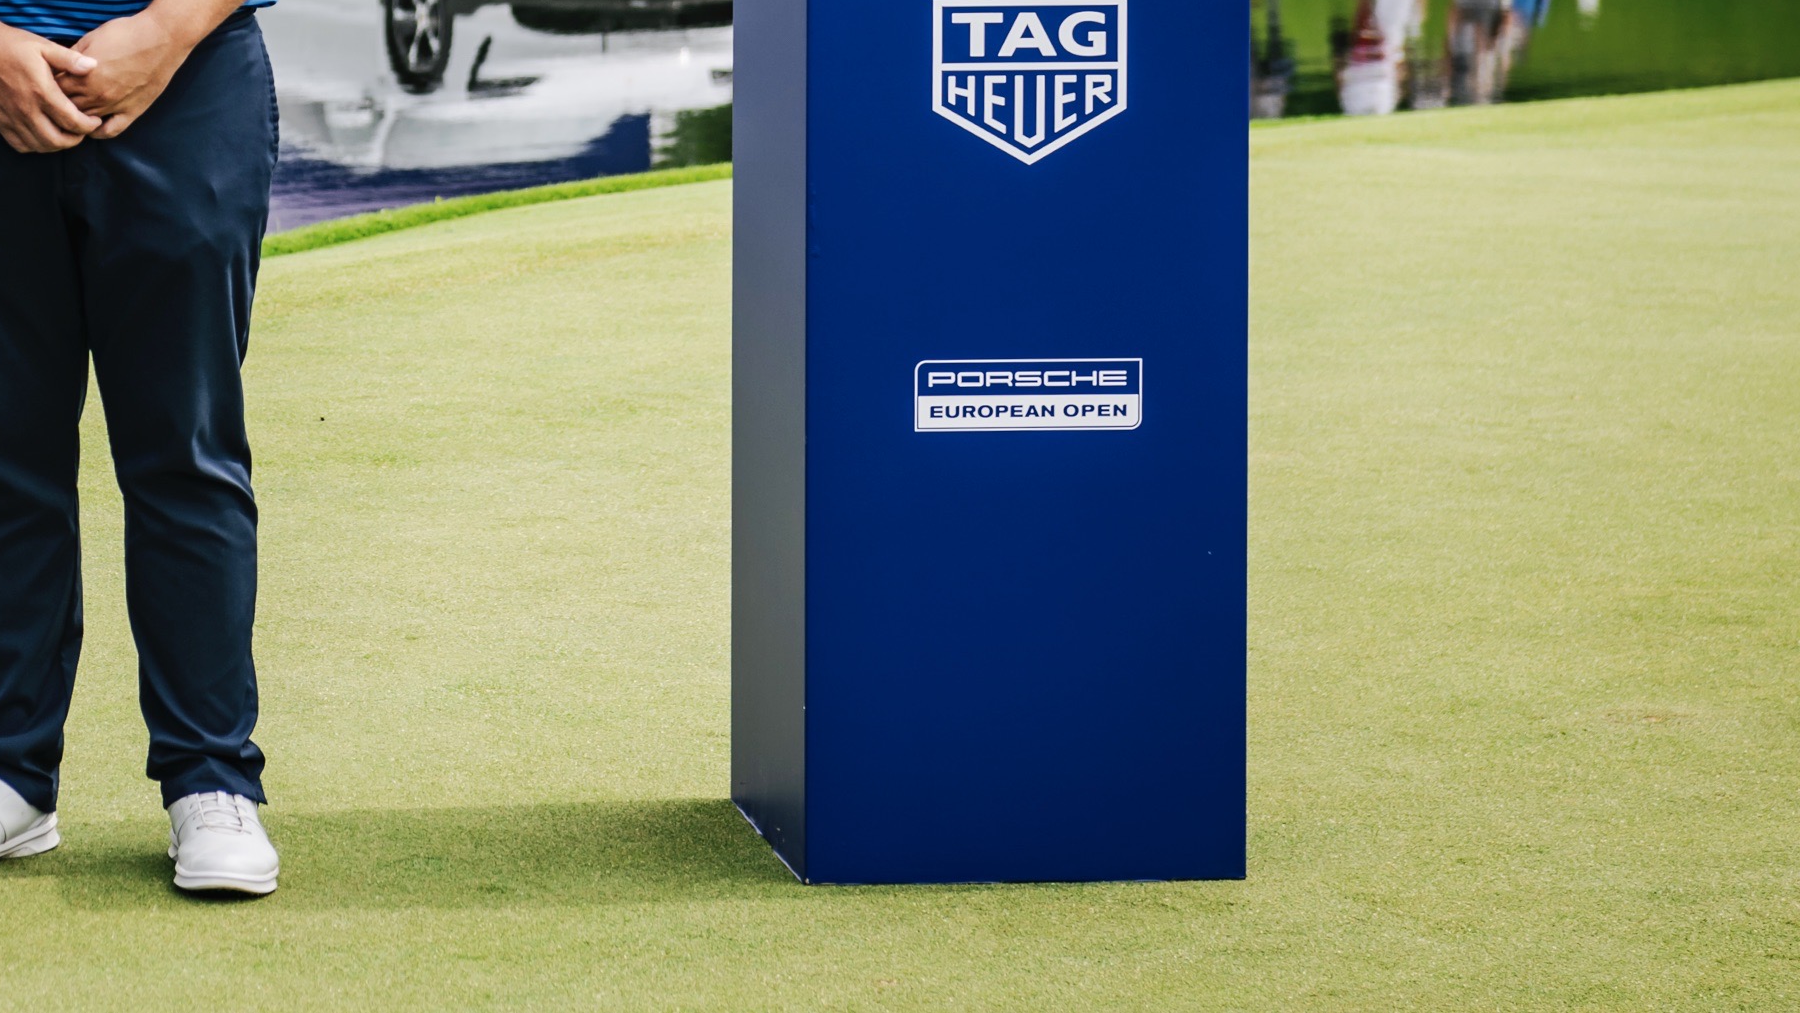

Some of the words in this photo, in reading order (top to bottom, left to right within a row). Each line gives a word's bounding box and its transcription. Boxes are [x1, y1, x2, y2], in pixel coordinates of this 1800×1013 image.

[951, 10, 1107, 57] TAG
[947, 74, 1112, 148] HEUER
[927, 370, 1128, 388] PORSCHE
[929, 404, 1055, 419] EUROPEAN
[1063, 403, 1128, 417] OPEN
